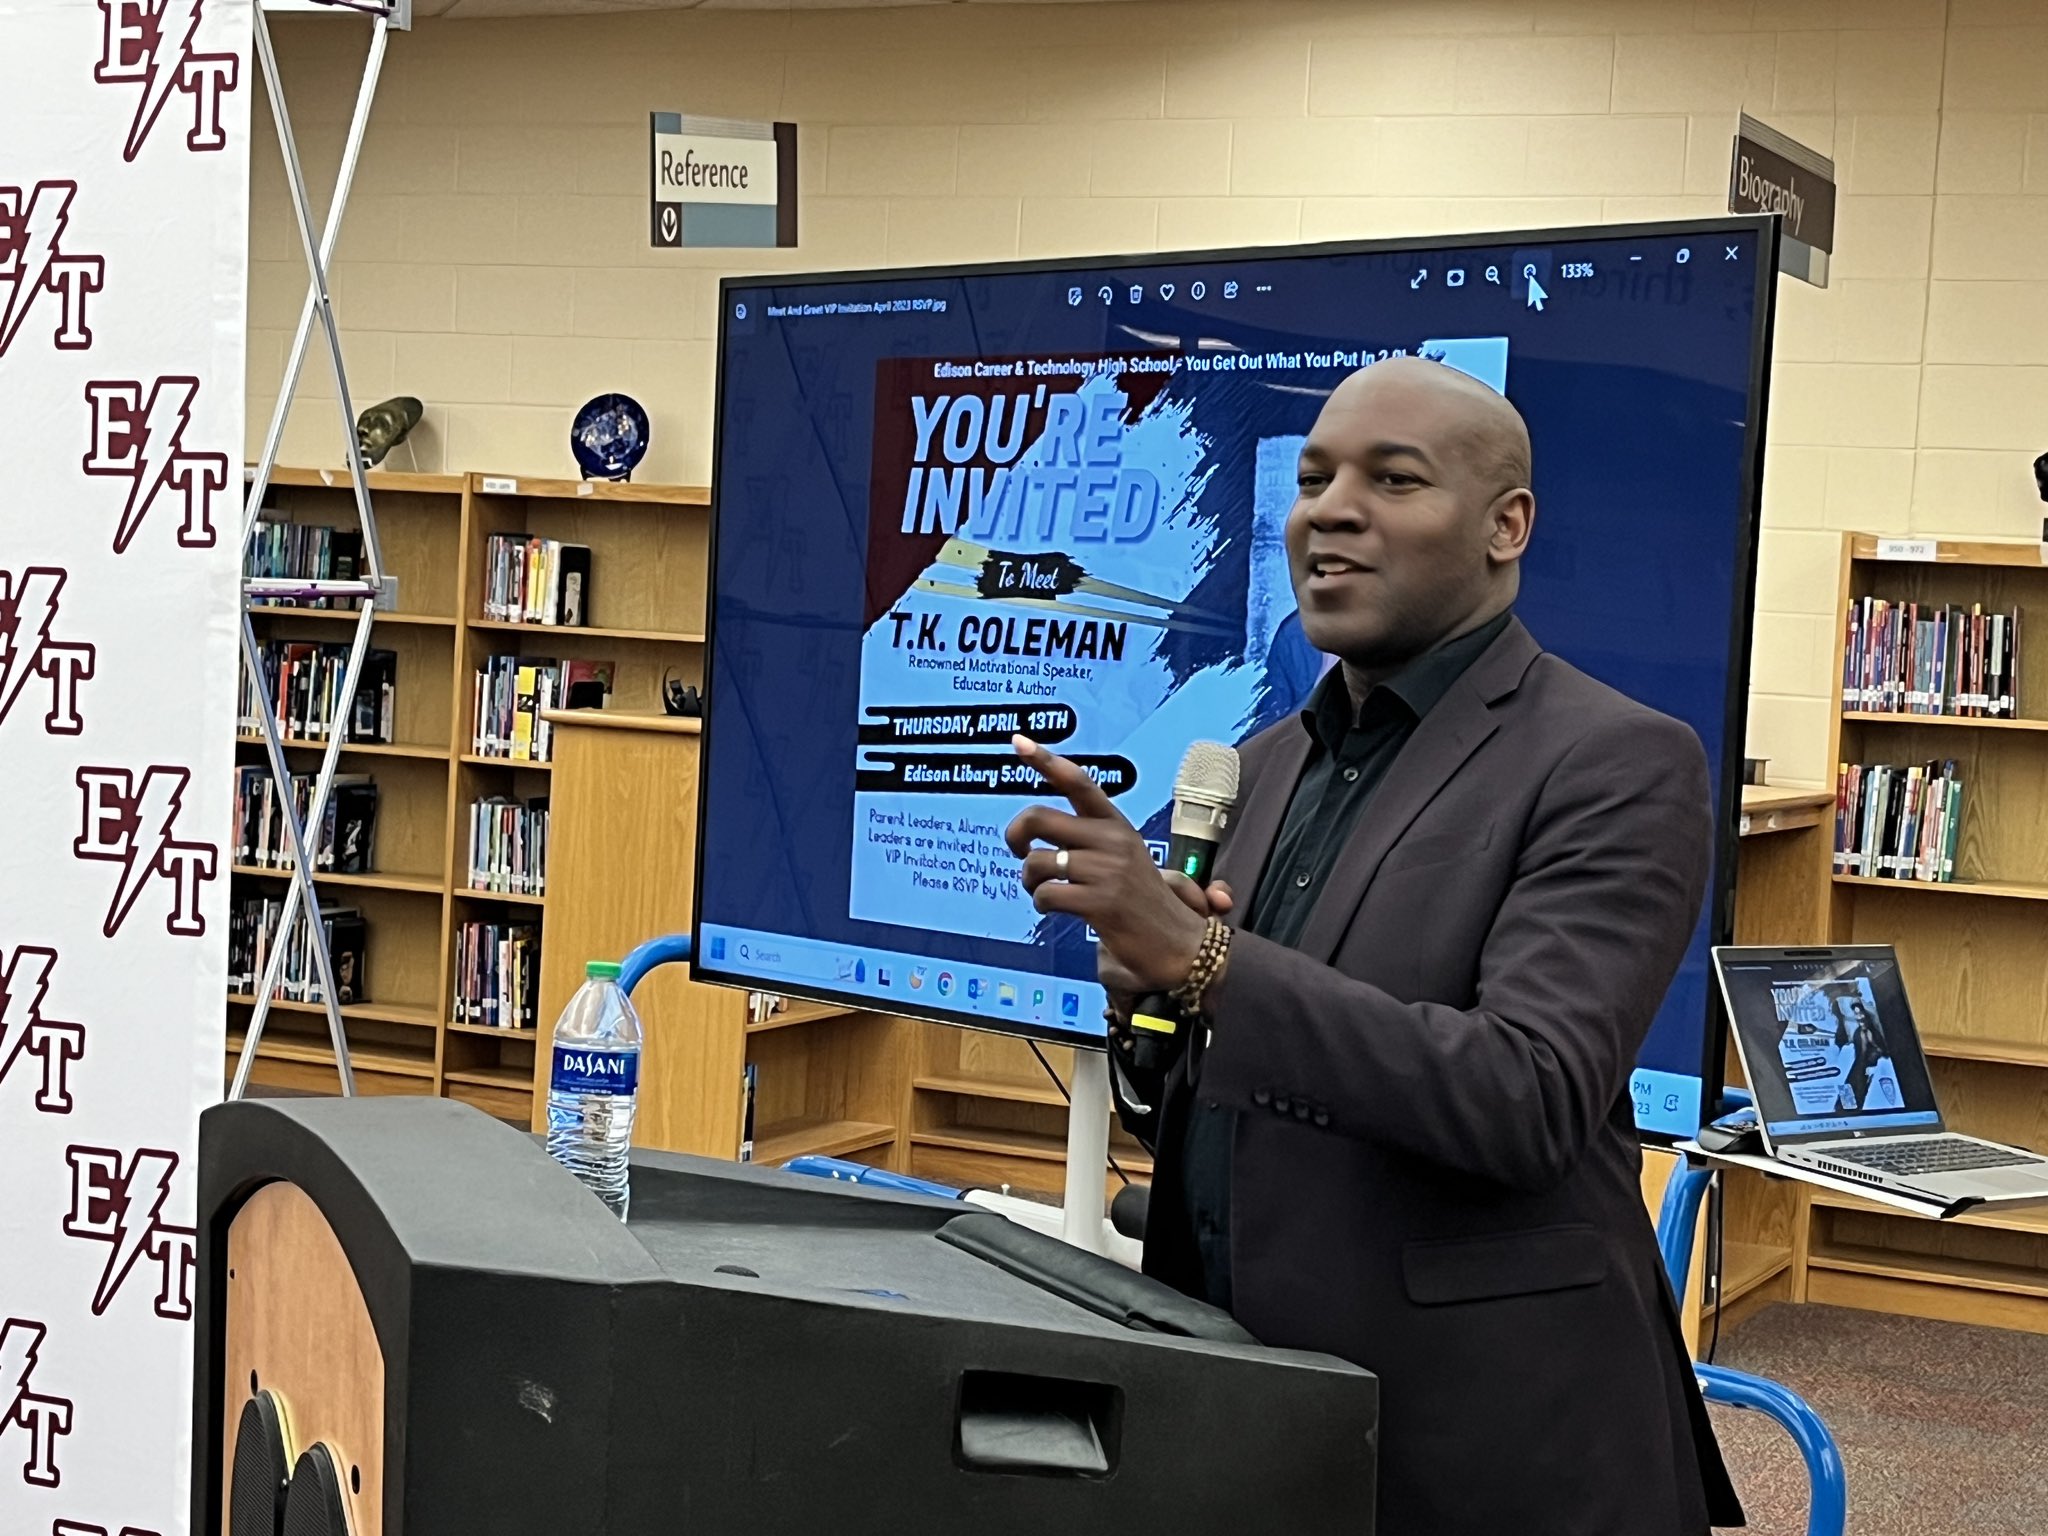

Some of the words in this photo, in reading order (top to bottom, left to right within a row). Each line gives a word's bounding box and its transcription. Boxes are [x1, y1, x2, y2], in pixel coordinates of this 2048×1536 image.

[661, 149, 749, 189] Reference
[1739, 155, 1805, 236] Biography
[1561, 262, 1594, 279] 133%
[934, 362, 972, 378] Edison
[974, 361, 1012, 377] Career
[1014, 361, 1024, 376] &
[1026, 359, 1095, 378] Technology
[1098, 357, 1127, 375] High
[1185, 355, 1209, 371] You
[1213, 354, 1235, 370] Get
[1238, 353, 1262, 370] Out
[1265, 352, 1301, 369] What
[1303, 352, 1330, 368] You
[1333, 351, 1358, 367] Put
[1361, 350, 1375, 366] In
[911, 384, 1128, 467] YOU'RE
[901, 467, 1160, 543] INVITED
[998, 562, 1014, 588] To
[1019, 561, 1059, 589] Meet
[889, 612, 946, 651] T.K.
[958, 615, 1127, 661] COLEMAN
[908, 654, 966, 670] Renowned
[969, 658, 1039, 676] Motivational
[1043, 663, 1094, 682] Speaker,
[953, 676, 1003, 693] Educator
[1005, 679, 1013, 694] &
[1017, 681, 1057, 696] Author
[893, 715, 974, 737] THURSDAY,
[977, 713, 1021, 732] APRIL
[1028, 710, 1068, 730] 13TH
[904, 764, 950, 783] Edison
[953, 764, 997, 788] Libary
[869, 808, 904, 826] Parent
[908, 812, 955, 834] Leaders,
[868, 827, 911, 846] Leaders
[915, 837, 933, 849] are
[978, 840, 989, 856] to
[885, 849, 900, 864] VIP
[959, 858, 987, 878] Only
[990, 860, 1022, 882] Recep
[913, 871, 949, 890] Please
[953, 876, 979, 893] RSVP
[982, 880, 997, 900] by
[564, 1052, 625, 1077] DASANI
[1633, 1081, 1651, 1095] PM
[1636, 1102, 1650, 1115] 23
